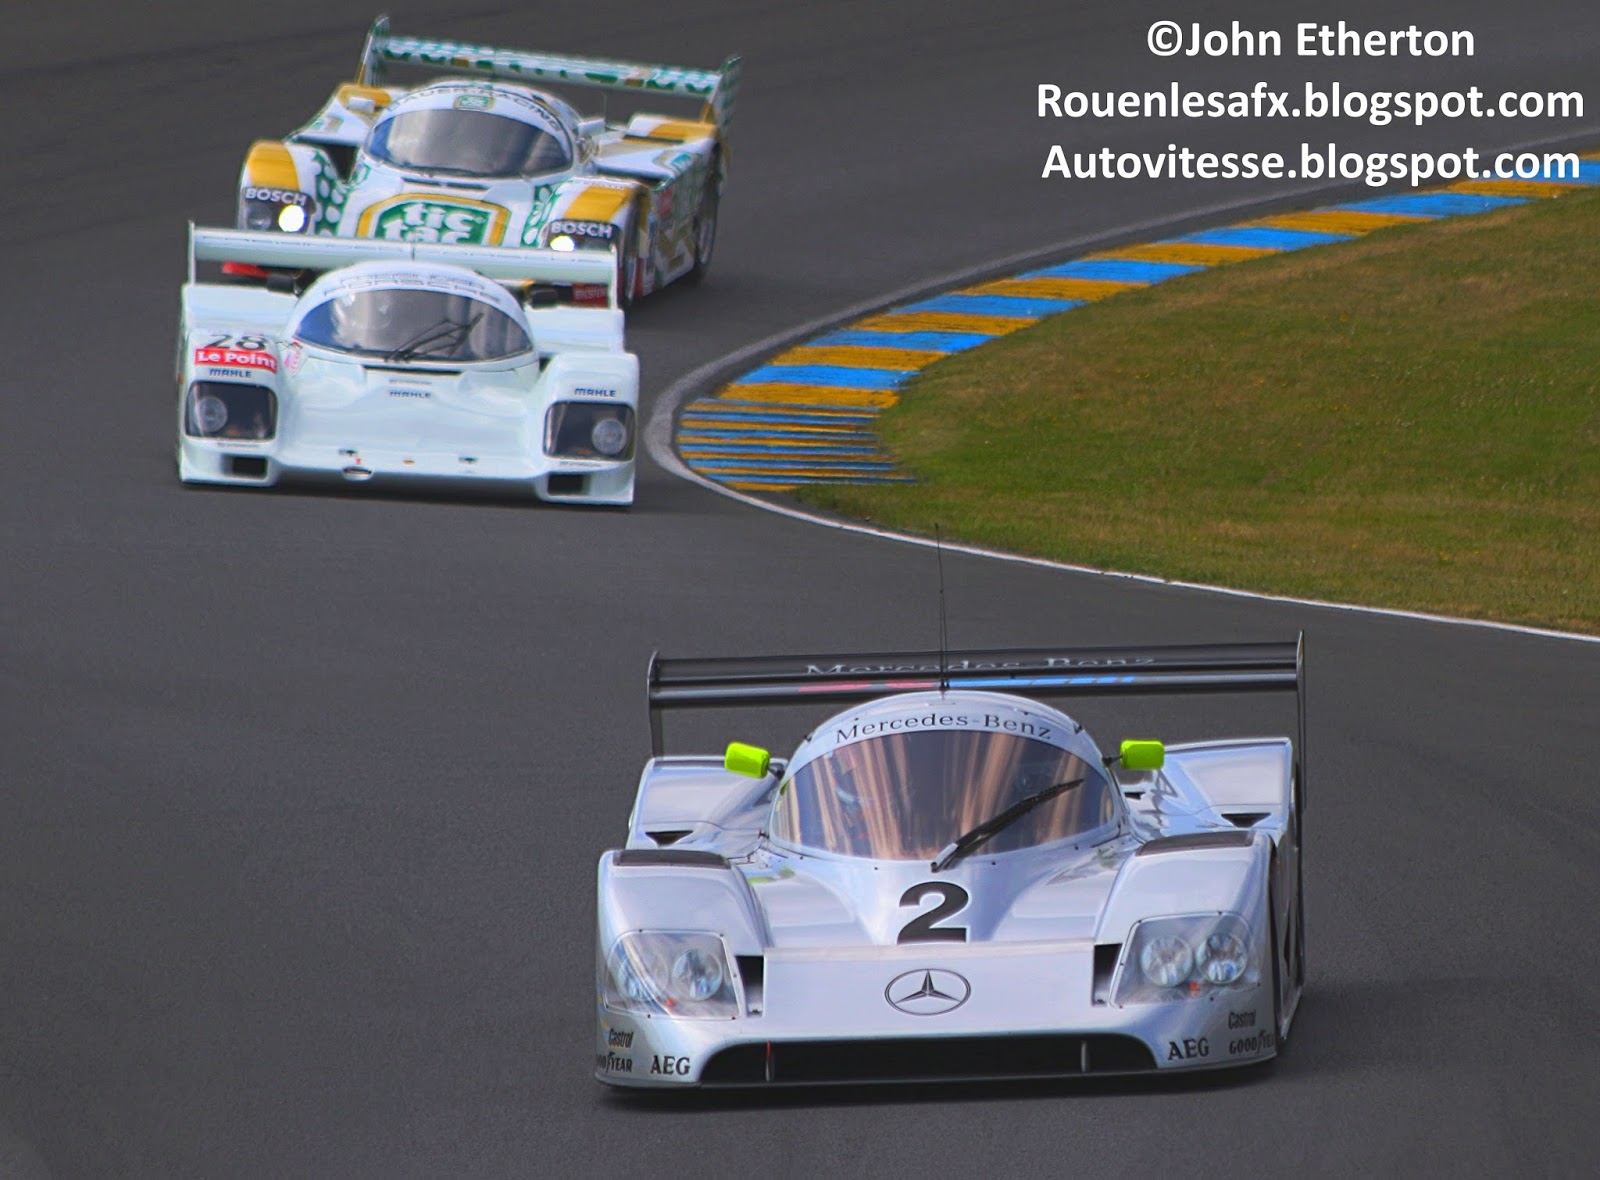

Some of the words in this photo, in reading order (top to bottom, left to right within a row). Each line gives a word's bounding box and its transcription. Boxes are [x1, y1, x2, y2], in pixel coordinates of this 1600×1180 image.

[245, 187, 307, 207] BOSCH
[403, 203, 475, 232] tic
[383, 219, 471, 245] tac
[551, 221, 612, 239] BOSCH
[204, 334, 268, 350] 28
[198, 351, 221, 362] Le
[224, 352, 277, 370] Point
[898, 881, 970, 945] 2
[1228, 1009, 1257, 1030] Castrol
[608, 1027, 634, 1048] Castrol
[1168, 1037, 1210, 1061] AEG
[650, 1054, 691, 1076] AEG
